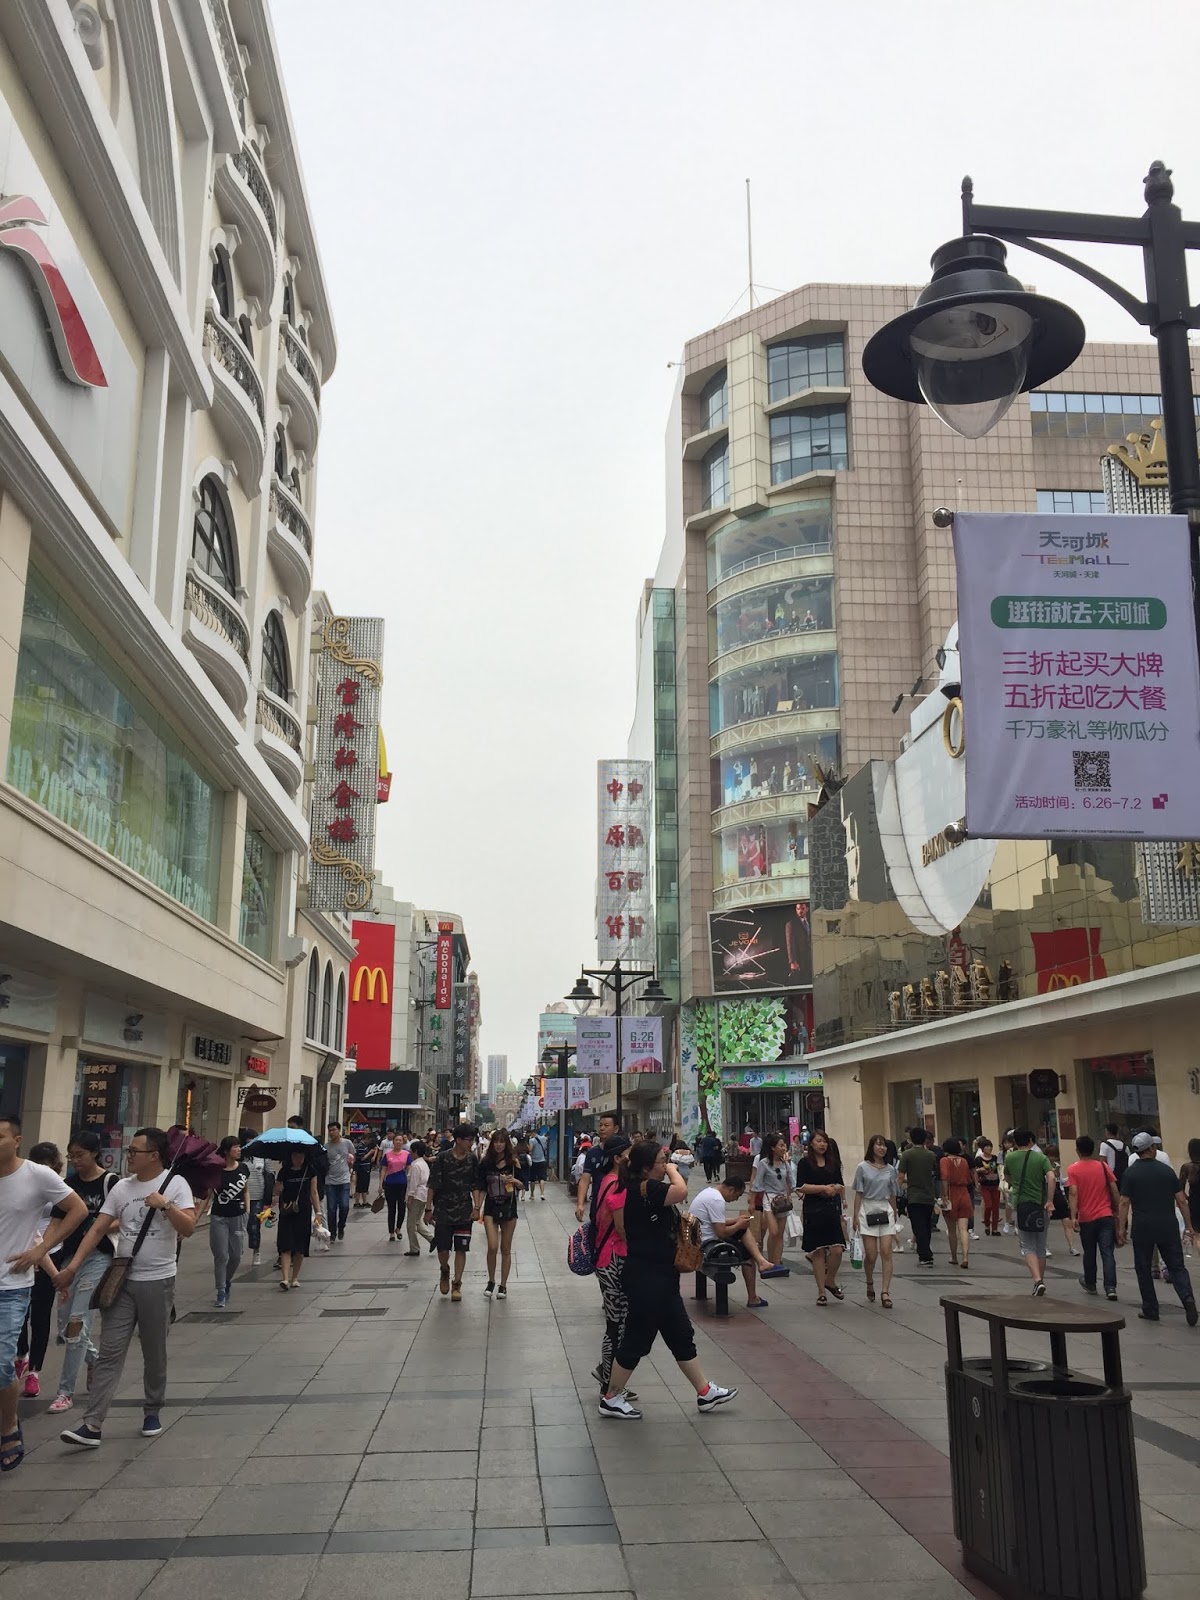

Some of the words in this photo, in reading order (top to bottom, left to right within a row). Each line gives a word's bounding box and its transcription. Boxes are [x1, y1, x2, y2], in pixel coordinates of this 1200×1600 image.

[1040, 531, 1110, 552] 天河城
[1008, 600, 1093, 624] 逛街就去
[1097, 602, 1151, 625] 天河城
[1002, 650, 1164, 677] 三折起买大牌
[1003, 683, 1167, 711] 五折起吃大餐
[1005, 719, 1170, 742] 千万豪礼等你瓜分
[440, 940, 450, 1004] McDonald's
[630, 1031, 654, 1042] 6.26
